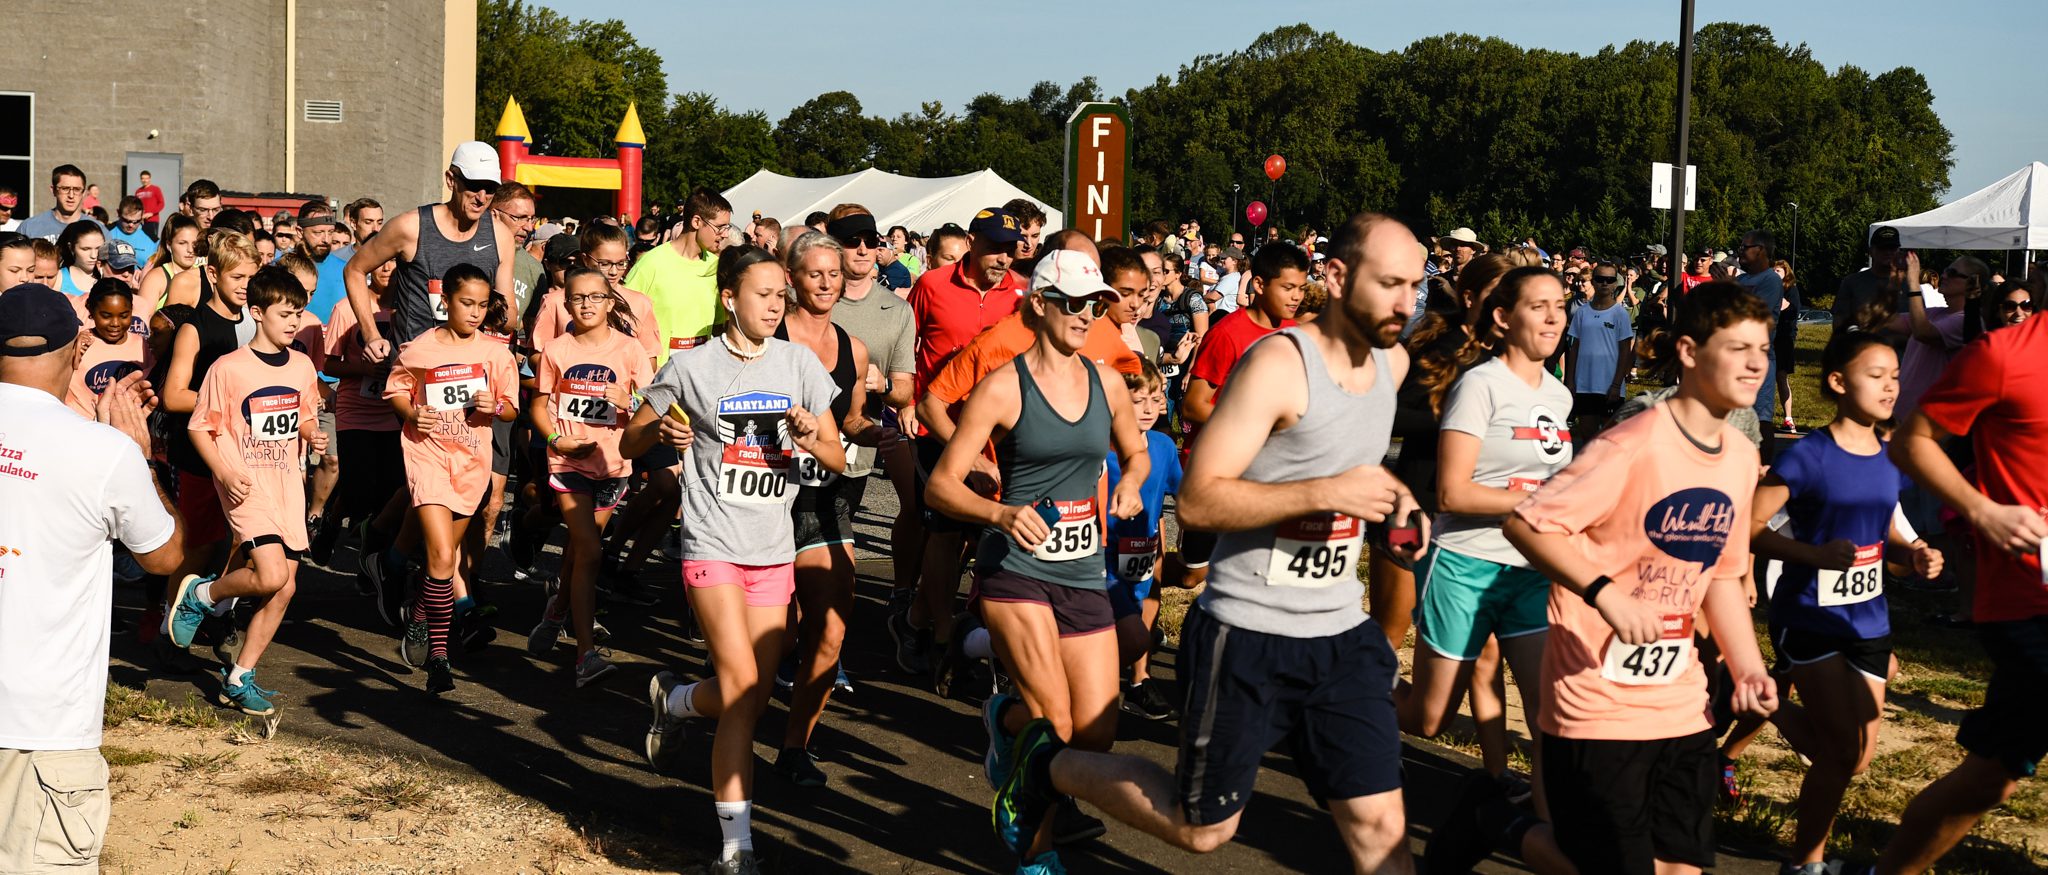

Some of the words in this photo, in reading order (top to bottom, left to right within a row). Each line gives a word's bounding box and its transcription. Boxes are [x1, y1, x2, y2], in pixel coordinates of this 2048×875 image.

[435, 369, 450, 378] race
[453, 366, 473, 375] result
[443, 384, 470, 405] 85
[570, 383, 586, 391] race
[567, 397, 609, 420] 422
[723, 399, 789, 412] MARYLAND
[262, 411, 299, 436] 492
[437, 411, 461, 424] ALK
[442, 423, 470, 436] RUN
[738, 449, 758, 459] race
[724, 468, 787, 498] 1000
[1045, 523, 1092, 554] 359
[1287, 544, 1349, 579] 495
[1637, 562, 1695, 587] WALK
[1832, 567, 1877, 598] 488
[1622, 645, 1681, 677] 437
